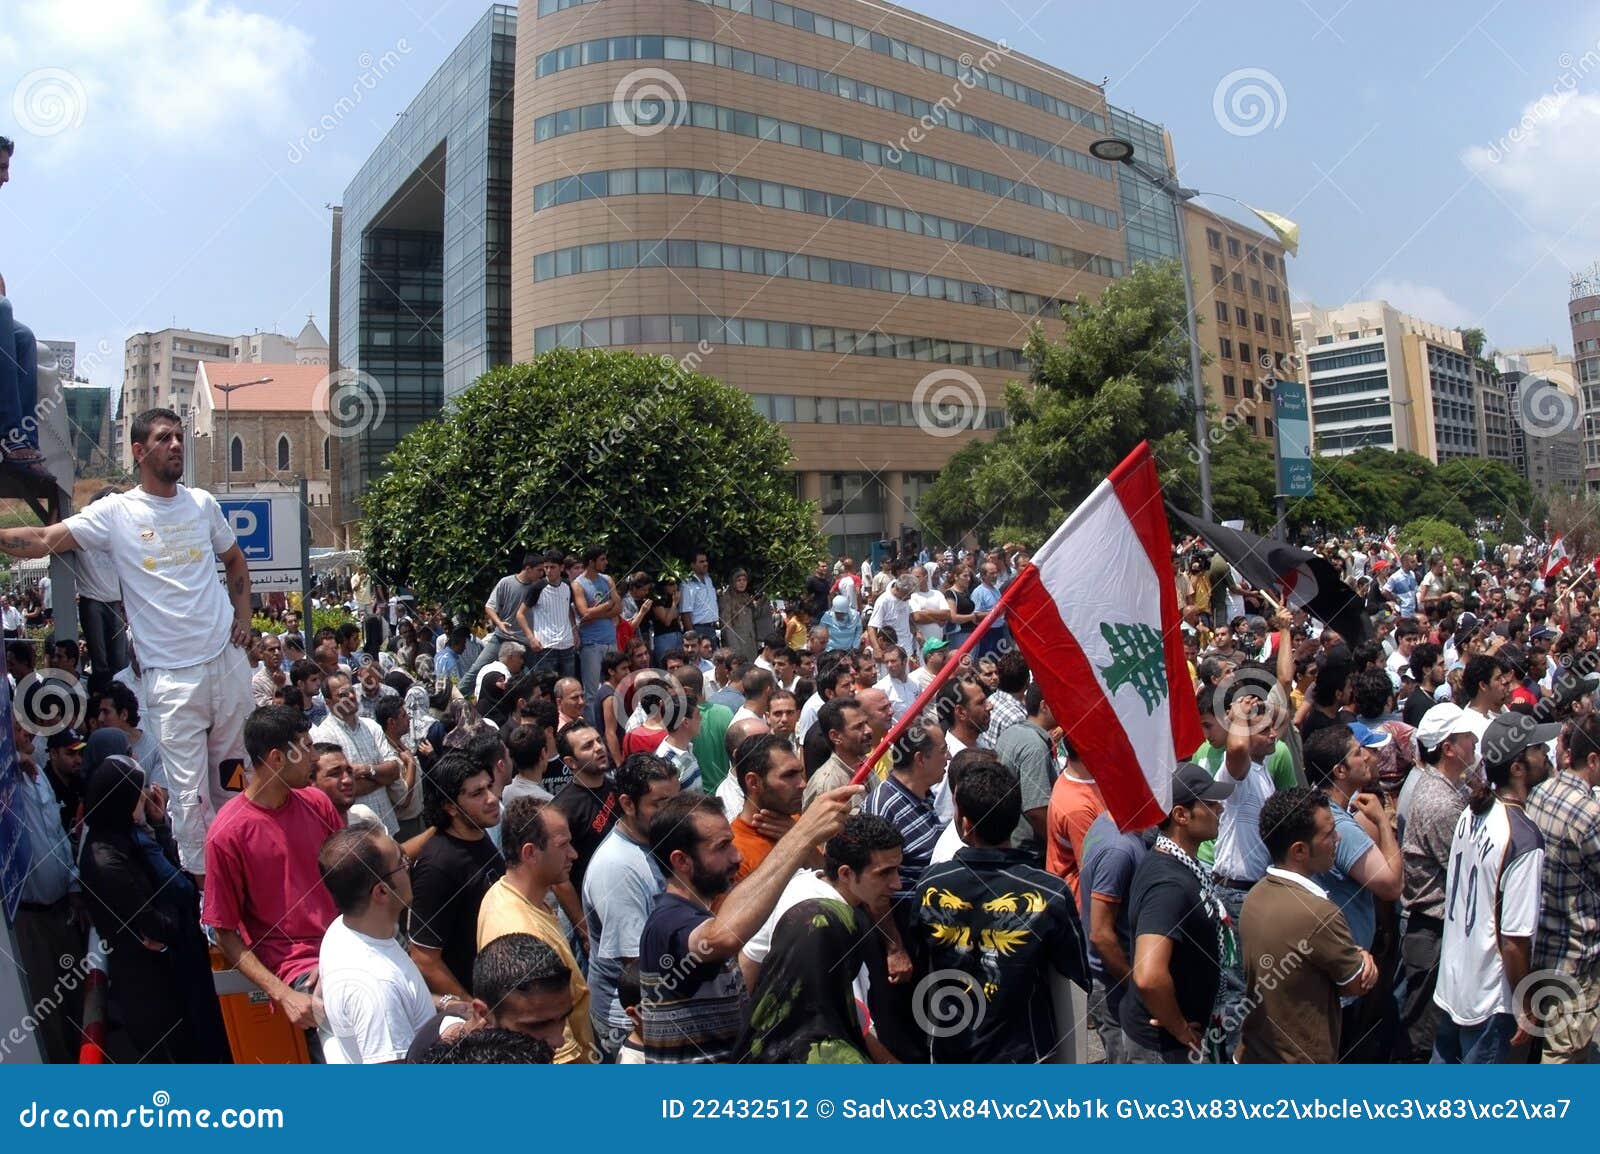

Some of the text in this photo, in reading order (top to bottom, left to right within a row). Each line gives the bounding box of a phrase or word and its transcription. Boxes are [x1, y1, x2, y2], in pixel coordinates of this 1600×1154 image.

[228, 510, 257, 542] P
[1459, 816, 1495, 864] OWEN
[1448, 851, 1478, 937] 10
